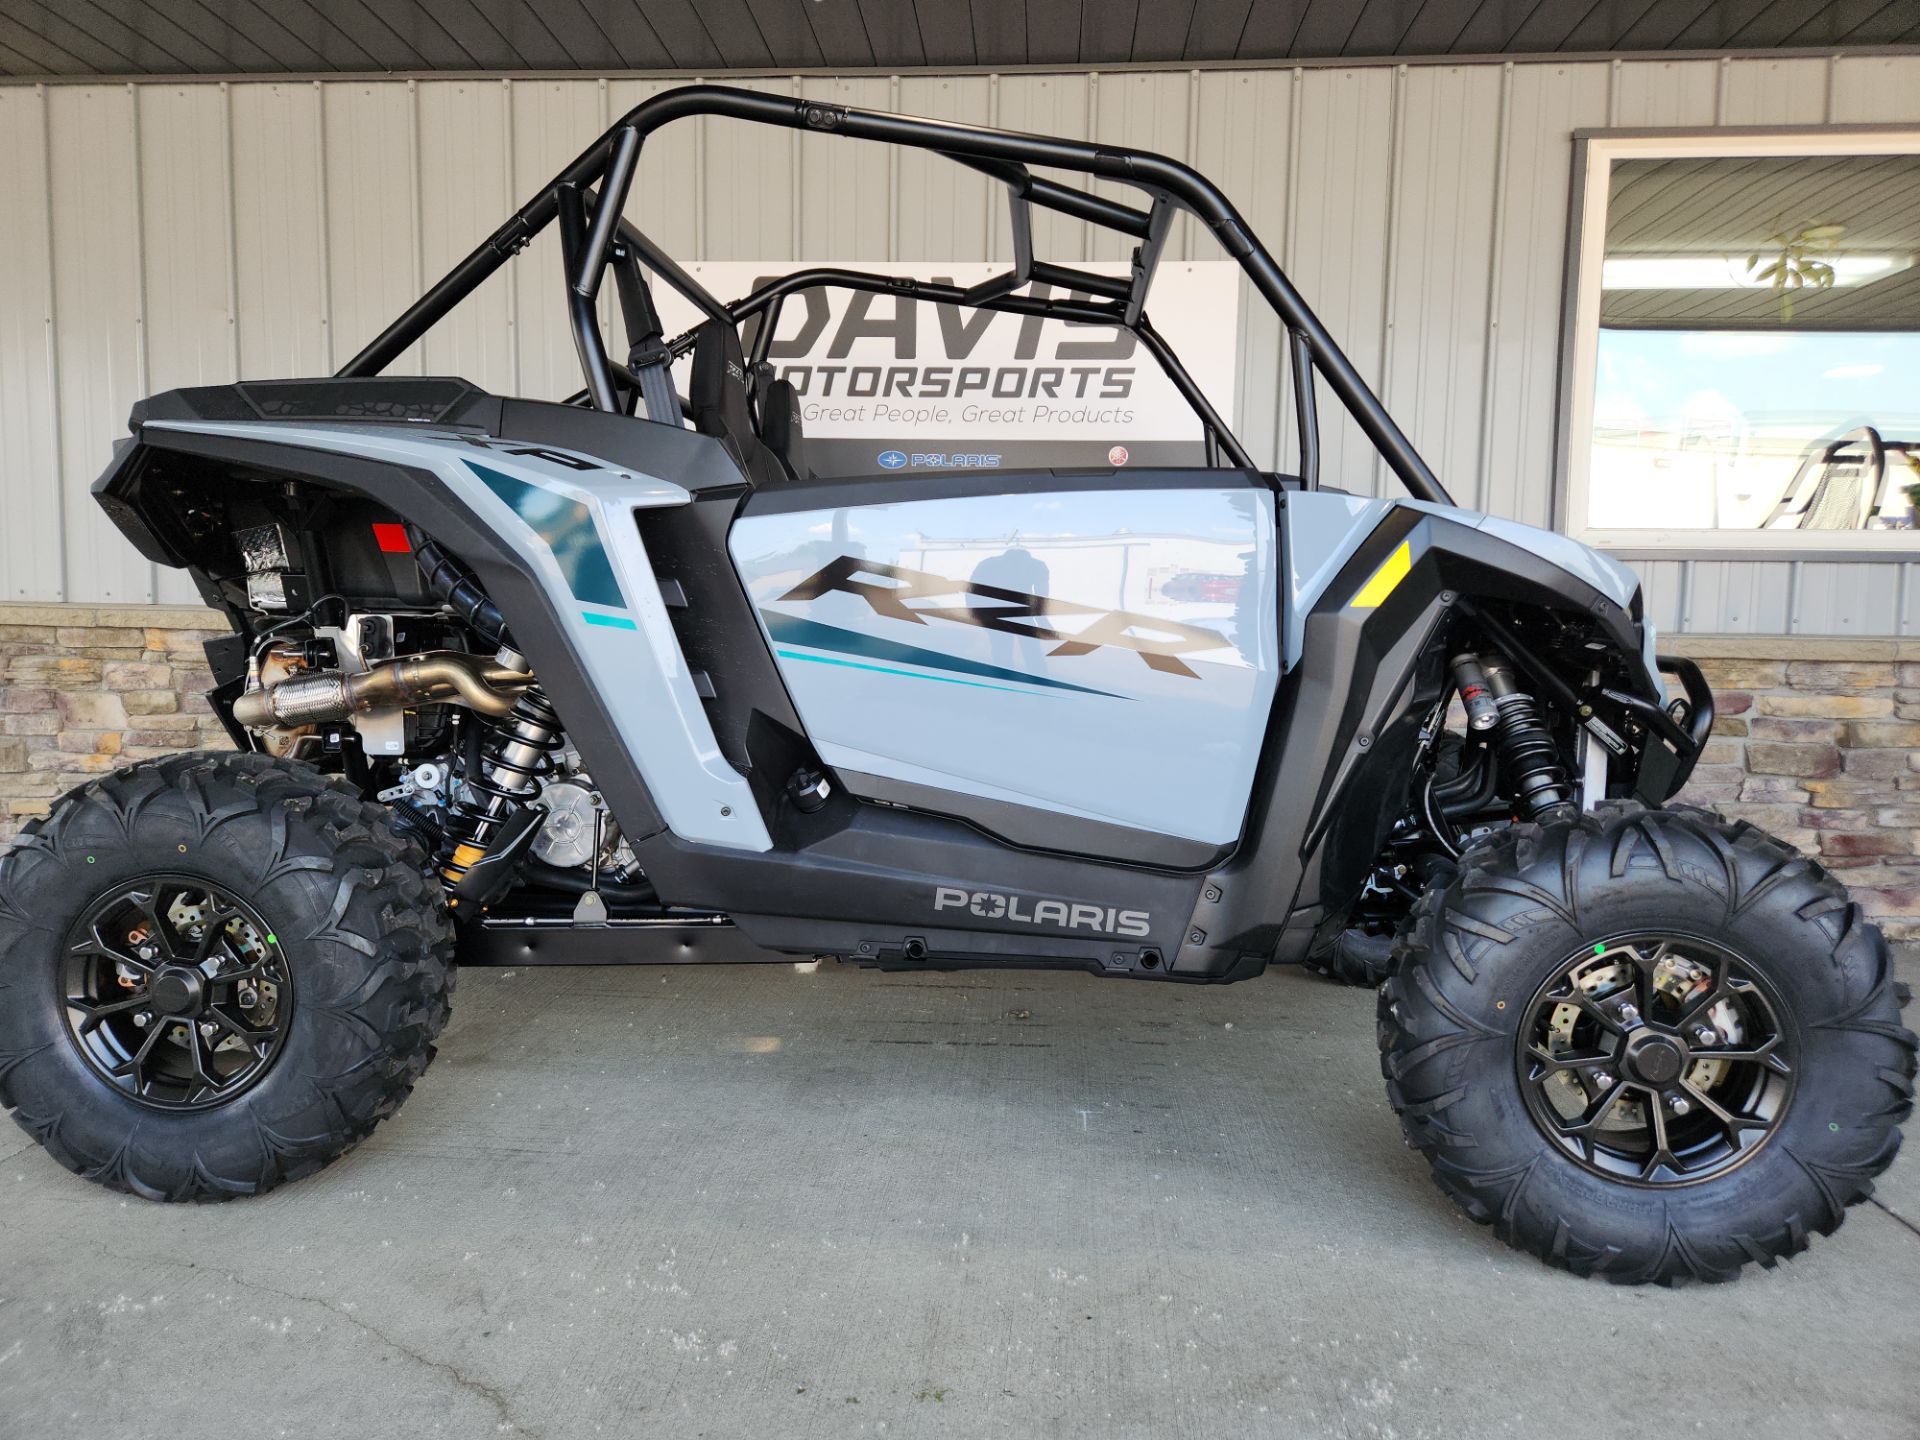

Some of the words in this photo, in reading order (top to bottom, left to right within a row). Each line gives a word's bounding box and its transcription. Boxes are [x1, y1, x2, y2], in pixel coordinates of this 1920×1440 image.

[740, 276, 1138, 360] DAVIS
[772, 366, 1136, 398] OTORSPORTS
[803, 403, 866, 422] Great
[873, 404, 952, 426] People,
[962, 404, 1026, 423] Great
[1033, 405, 1135, 423] Products
[911, 453, 1000, 468] POLARIS
[775, 554, 1234, 680] RZR
[933, 886, 1151, 937] POLARIS
